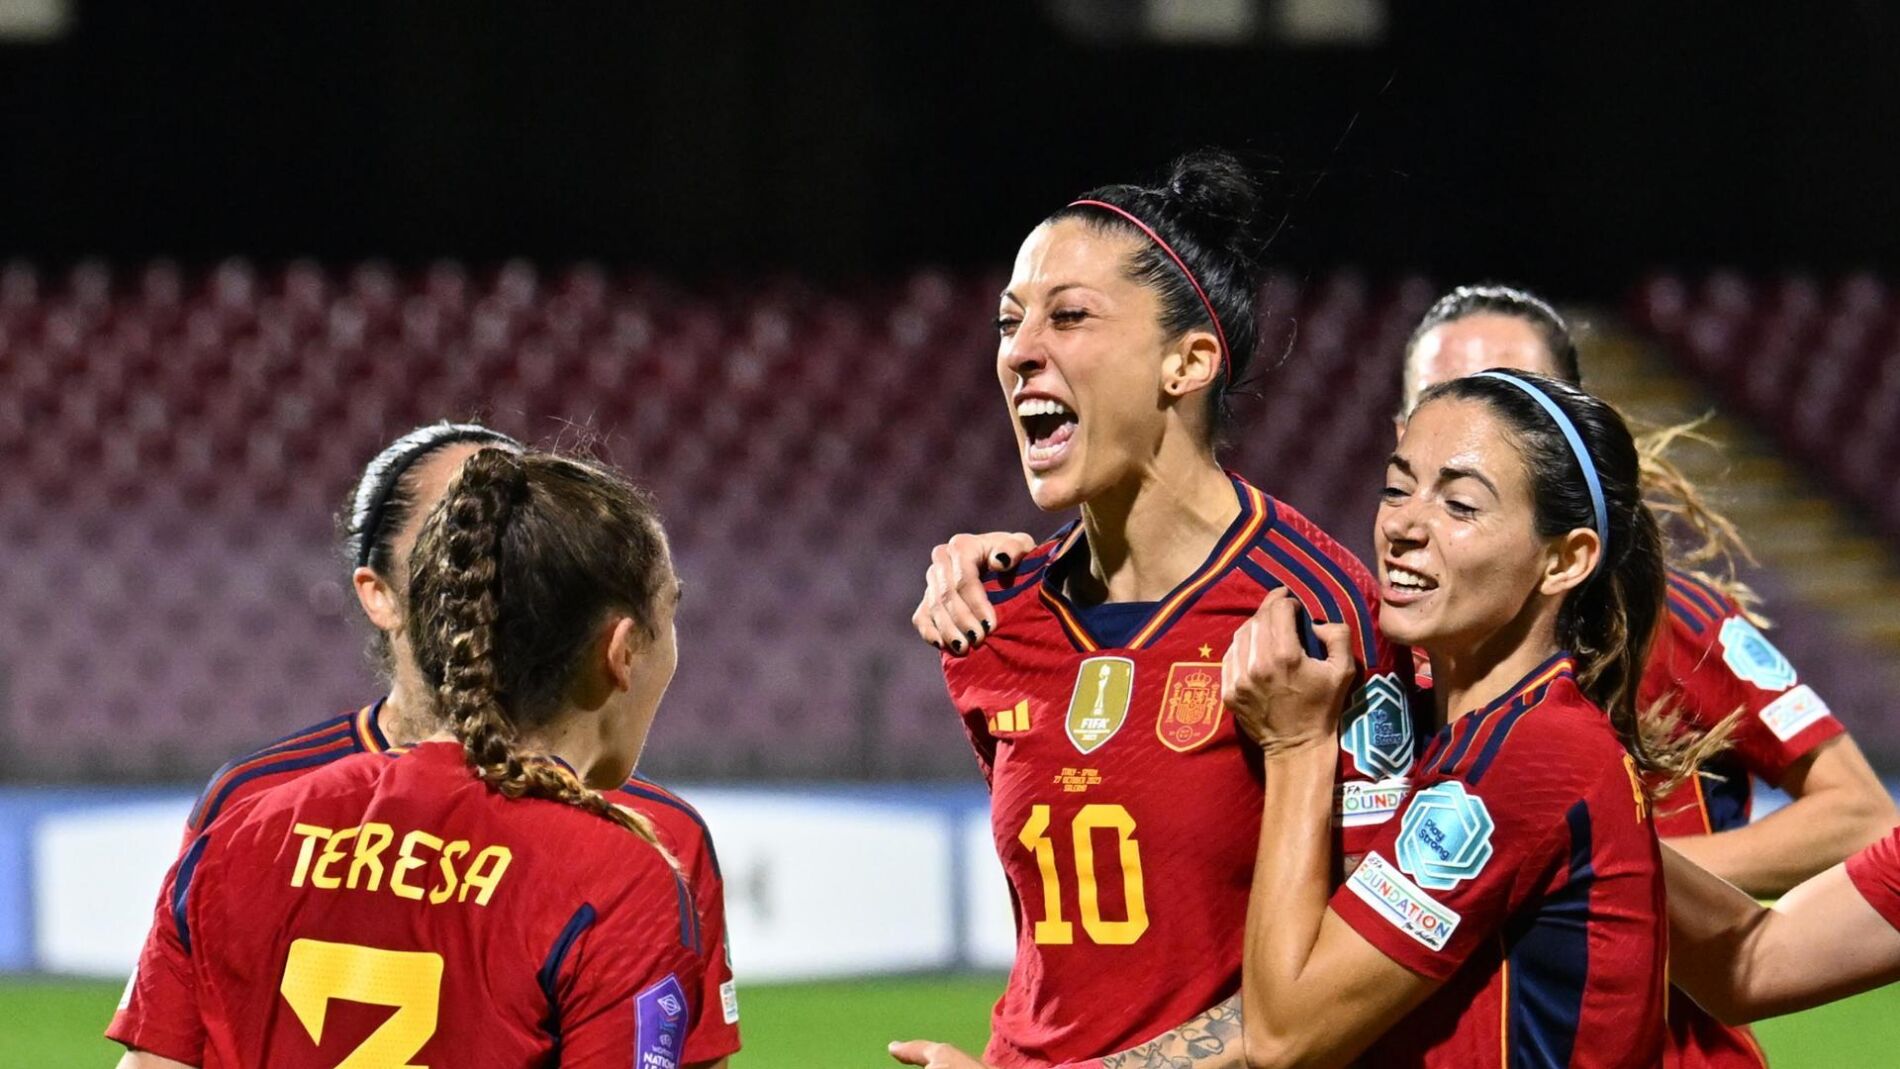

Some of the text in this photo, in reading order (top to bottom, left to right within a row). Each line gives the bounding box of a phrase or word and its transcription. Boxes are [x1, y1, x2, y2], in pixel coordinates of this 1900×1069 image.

[1081, 718, 1109, 730] FIFA
[1419, 828, 1450, 861] Strong
[1424, 818, 1446, 842] Play
[290, 822, 512, 907] TERESA
[1018, 804, 1149, 945] 10
[1359, 863, 1451, 939] FOUNDATION
